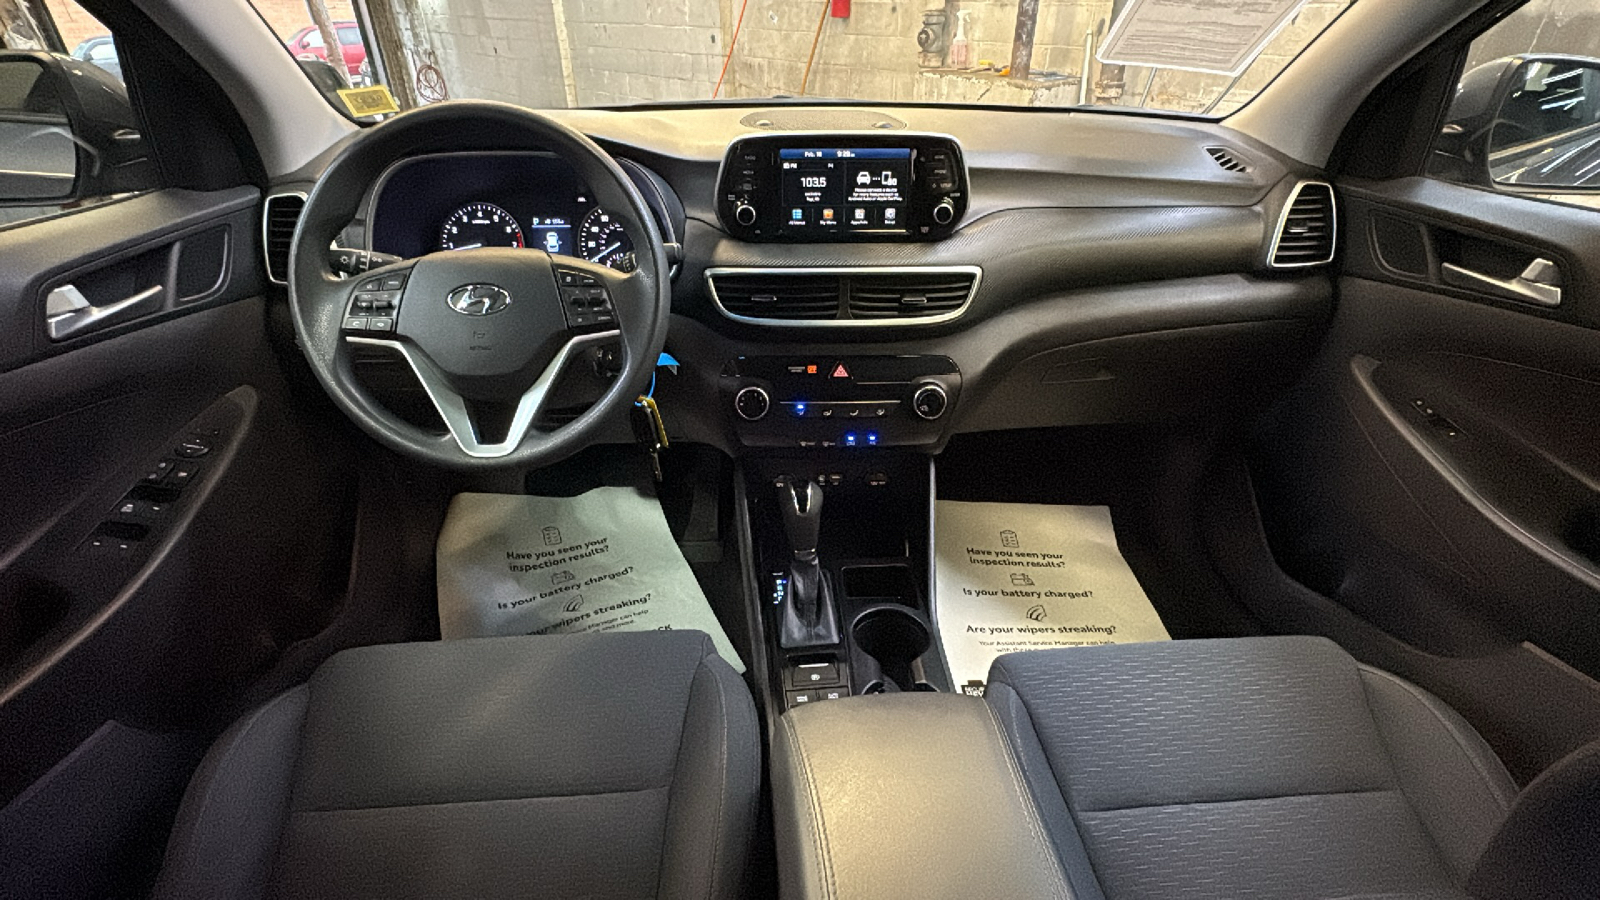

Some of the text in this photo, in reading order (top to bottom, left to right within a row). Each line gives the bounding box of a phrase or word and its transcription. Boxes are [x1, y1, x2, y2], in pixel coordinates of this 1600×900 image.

[800, 177, 827, 188] 103.5
[533, 217, 539, 225] P
[451, 226, 458, 234] 2
[506, 537, 608, 560] Have you seen your
[966, 547, 992, 556] Have
[1015, 551, 1039, 559] seen
[1040, 552, 1064, 560] your
[509, 545, 609, 573] inspection results?
[969, 556, 1066, 569] inspection results?
[497, 566, 634, 610] Is your battery charged?
[962, 588, 1093, 599] Is your battery charged?
[550, 612, 591, 631] wipers
[593, 593, 652, 616] streaking?
[966, 625, 1117, 635] Are your wipers streaking?
